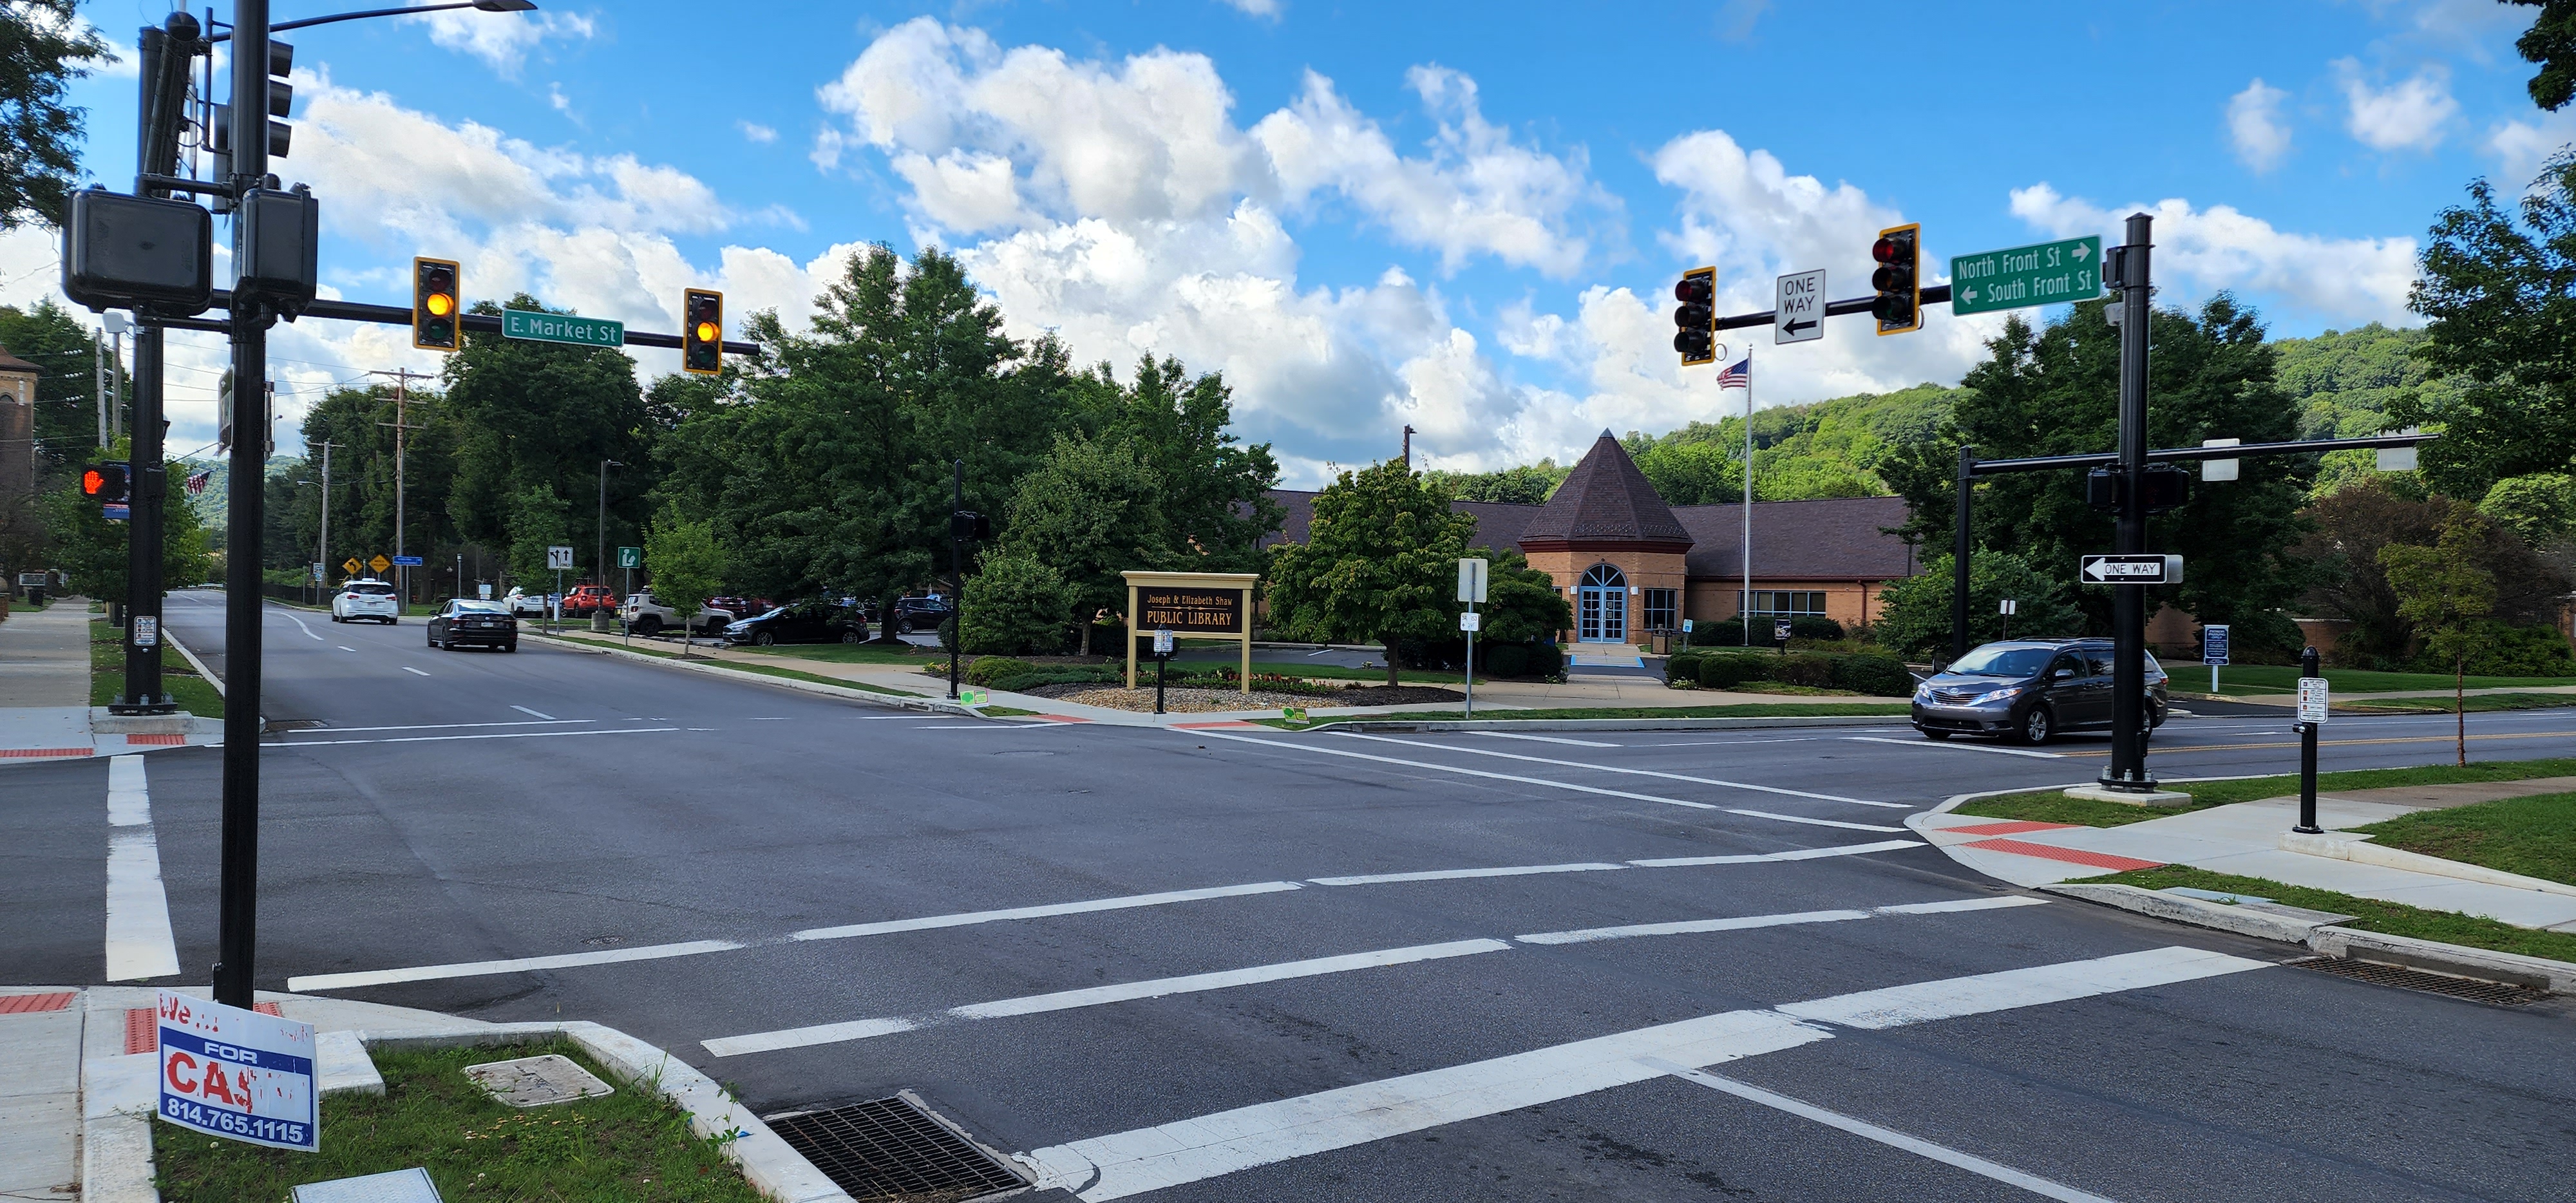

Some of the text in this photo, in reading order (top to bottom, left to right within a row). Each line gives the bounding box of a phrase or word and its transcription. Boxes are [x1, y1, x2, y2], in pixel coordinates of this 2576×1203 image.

[1958, 246, 2061, 280] North Front St
[1785, 276, 1815, 296] ONE
[1987, 269, 2092, 303] South Front St
[1784, 295, 1815, 315] WAY
[511, 316, 616, 342] E. Market St
[2105, 564, 2157, 574] ONE WAY
[1147, 594, 1233, 605] Joseph & Elizabeth Shaw
[1146, 611, 1232, 625] PUBLIC LIBRARY
[160, 993, 191, 1025] We
[204, 1041, 258, 1064] FOR
[167, 1098, 305, 1142] 814.765.1115
